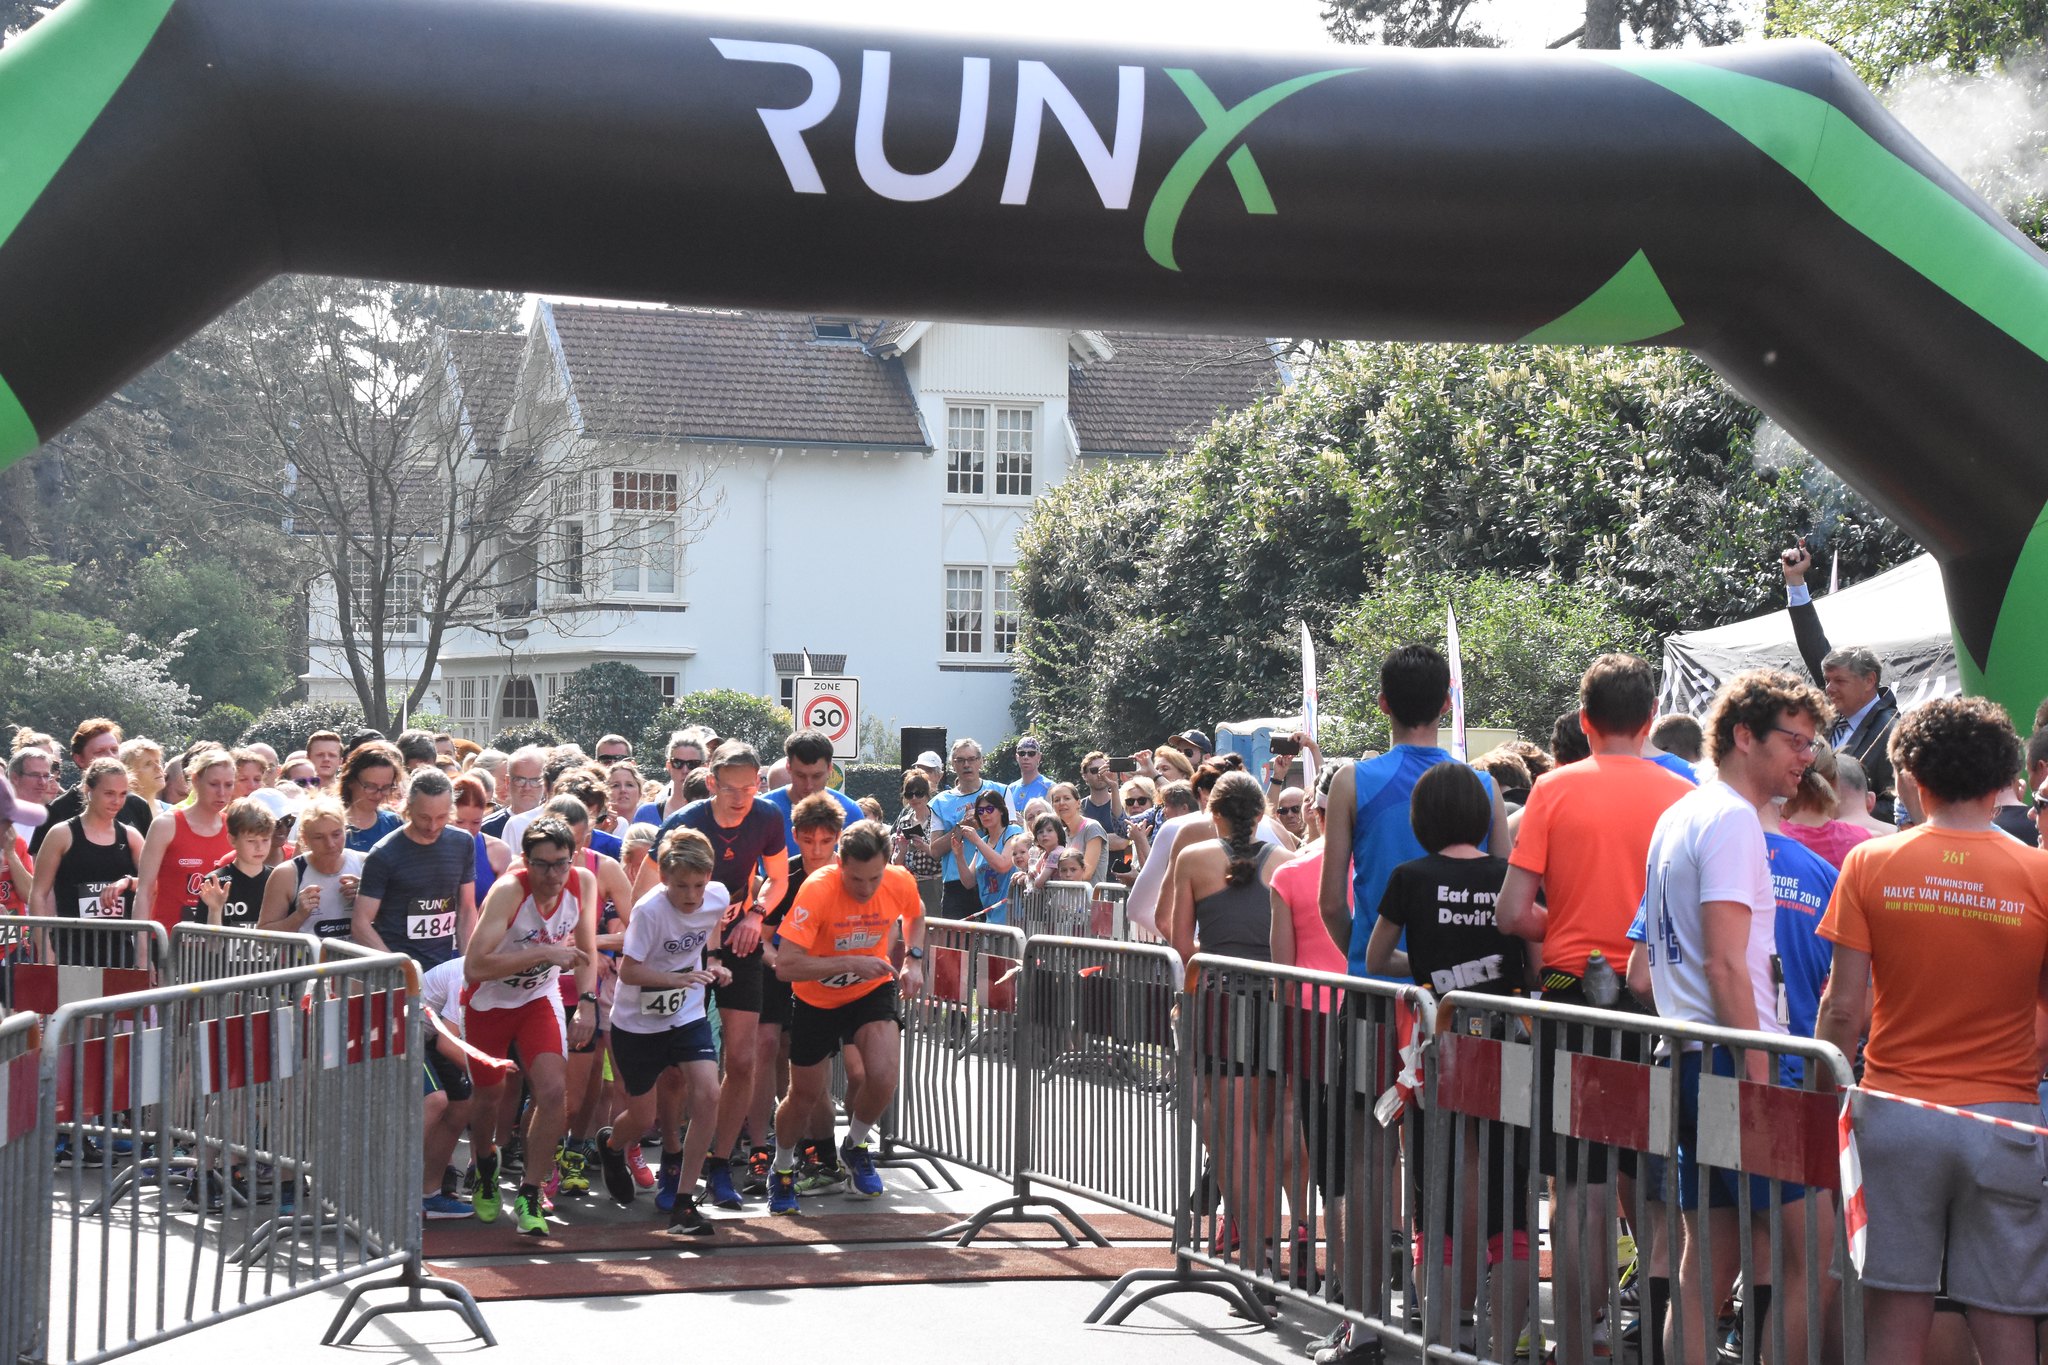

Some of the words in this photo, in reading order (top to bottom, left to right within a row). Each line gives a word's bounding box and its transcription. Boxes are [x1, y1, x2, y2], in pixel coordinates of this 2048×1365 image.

[709, 37, 1372, 272] RUNX
[813, 683, 841, 691] ZONE
[812, 708, 842, 727] 30
[1925, 875, 1984, 893] VITAMINSTORE
[418, 897, 451, 912] RUNX
[1437, 885, 1469, 903] Eat
[1473, 892, 1501, 907] my
[1799, 891, 1821, 908] 2018
[1883, 886, 1916, 899] HALVE
[1919, 887, 1940, 901] VAN
[1943, 891, 1996, 910] HAARLEM
[2000, 900, 2025, 914] 2017
[1438, 907, 1498, 926] Devil's
[1885, 900, 1901, 910] RUN
[1903, 902, 1935, 913] BEYOND
[1938, 905, 1960, 917] YOUR
[1962, 908, 2022, 927] EXPECTATIONS
[413, 918, 451, 937] 484
[1430, 954, 1505, 994] DIRT
